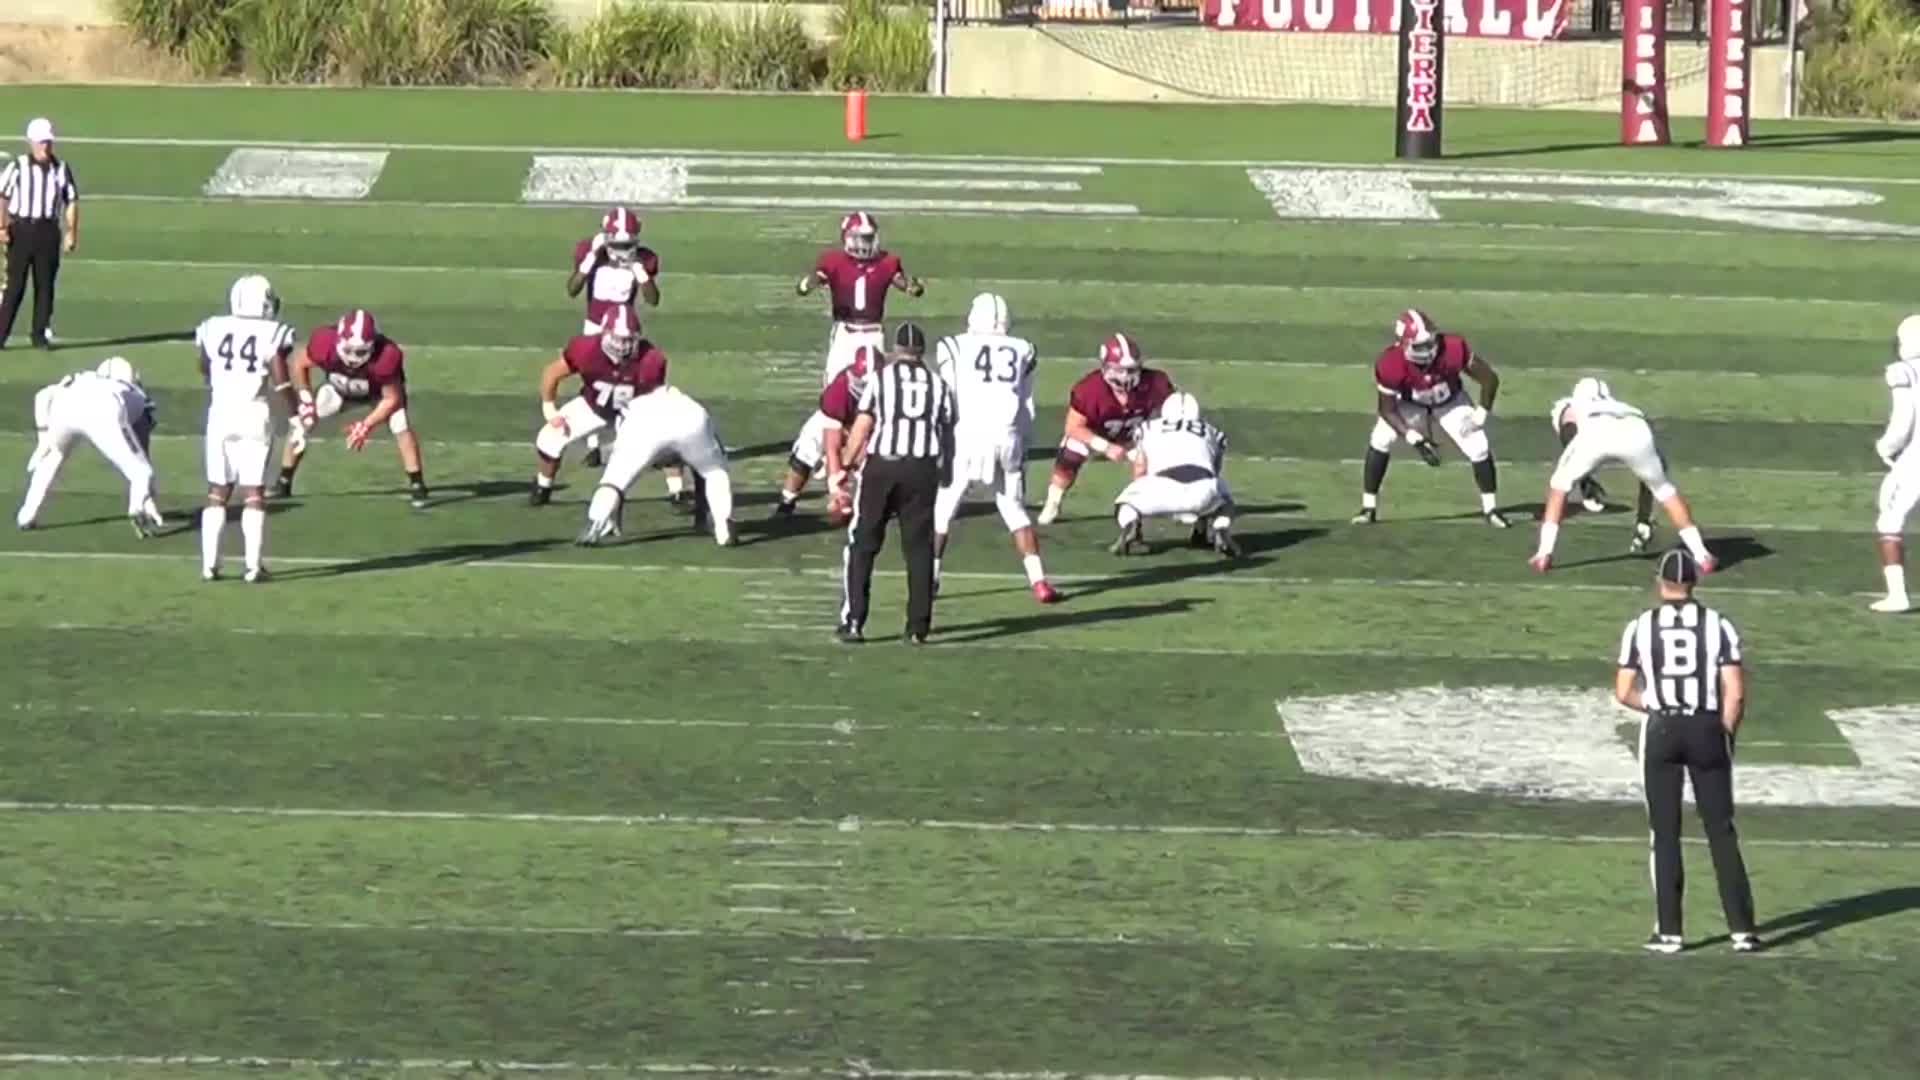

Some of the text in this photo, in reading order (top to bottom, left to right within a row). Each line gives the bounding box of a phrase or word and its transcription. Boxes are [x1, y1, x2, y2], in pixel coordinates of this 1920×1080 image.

[1407, 0, 1437, 131] IERRA
[1722, 0, 1745, 145] IERRA
[855, 275, 866, 311] 1
[217, 332, 259, 374] 44
[974, 344, 1019, 383] 43
[1660, 628, 1698, 676] B
